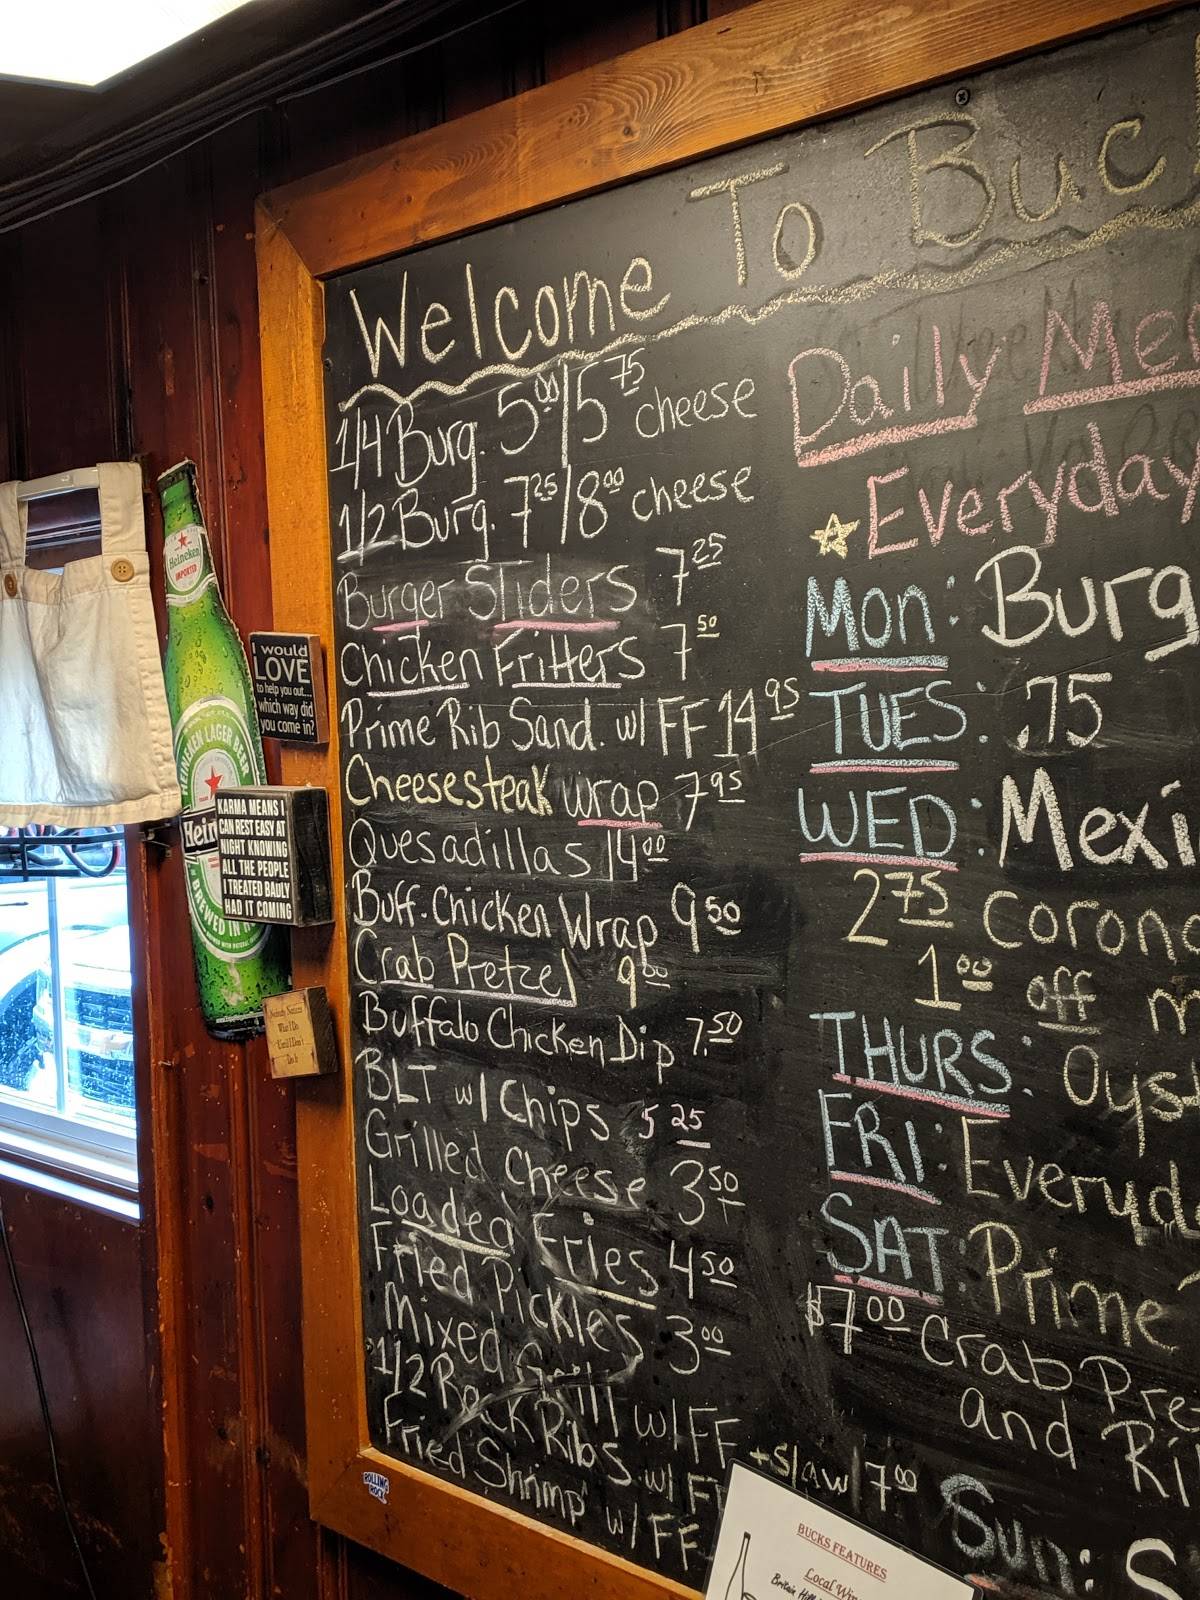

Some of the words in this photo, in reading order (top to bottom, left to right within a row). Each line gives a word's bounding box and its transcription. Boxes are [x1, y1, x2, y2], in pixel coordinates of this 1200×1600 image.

[350, 256, 672, 378] Welcome
[687, 162, 816, 287] To
[864, 33, 1200, 248] Buc
[788, 325, 1002, 458] Daily
[330, 406, 381, 490] 1/4
[387, 399, 486, 503] Burg.
[636, 377, 757, 439] cheese
[337, 490, 388, 566] 1/2
[398, 488, 496, 563] Burg.
[632, 465, 755, 522] cheese
[867, 422, 1200, 560] Everyday
[169, 548, 200, 569] Heineken
[337, 571, 455, 640] Burger
[464, 552, 638, 622] Sliders
[974, 545, 1200, 662] Burg
[252, 642, 256, 654] I
[260, 644, 308, 657] would
[254, 656, 310, 683] LOVE
[340, 633, 483, 688] Chicken
[494, 627, 646, 688] Fritters
[256, 683, 264, 693] to
[264, 683, 279, 697] help
[280, 686, 292, 697] you
[258, 697, 281, 714] which
[282, 703, 298, 719] way
[301, 701, 313, 717] did
[341, 696, 437, 748] Prime
[437, 698, 500, 751] Rib
[508, 696, 604, 752] Sand.
[1017, 672, 1113, 749] .75
[181, 730, 204, 796] HEINEKEN
[205, 724, 232, 746] LAGER
[233, 736, 250, 778] BEER
[260, 719, 276, 733] you
[277, 720, 300, 733] come
[302, 719, 315, 735] in?
[217, 799, 247, 815] KARMA
[249, 799, 278, 816] MEANS
[281, 799, 285, 816] I
[345, 752, 554, 817] Cheesesteak
[999, 767, 1200, 871] Mexi
[183, 816, 218, 848] Hein
[219, 819, 234, 834] CAN
[236, 819, 254, 835] REST
[255, 819, 275, 836] EASY
[276, 820, 285, 837] AT
[220, 839, 245, 855] NIGHT
[248, 840, 287, 857] KNOWING
[349, 817, 592, 878] Quesadillas
[222, 859, 237, 874] ALL
[239, 860, 256, 876] THE
[258, 860, 289, 878] PEOPLE
[224, 879, 227, 894] I
[228, 879, 263, 896] TREATED
[265, 881, 290, 898] BADLY
[191, 878, 226, 935] BREWED
[228, 920, 241, 937] IN
[224, 899, 242, 915] HAD
[245, 900, 254, 916] IT
[257, 901, 292, 919] COMING
[350, 868, 428, 927] Buff.
[432, 884, 552, 938] Chicken
[559, 891, 658, 965] Wrap
[354, 929, 436, 984] Crab
[450, 932, 577, 1005] Pretzel
[1027, 965, 1097, 1023] off
[358, 989, 480, 1047] Buffalo
[488, 1006, 605, 1067] Chicken
[610, 1014, 675, 1084] Dip
[355, 1047, 437, 1104] BLT
[500, 1079, 609, 1151] Chips
[365, 1108, 483, 1180] Grilled
[504, 1146, 646, 1209] Cheese
[961, 1115, 1200, 1247] Everyd
[369, 1163, 516, 1252] Loaded
[533, 1212, 659, 1297] Fries
[370, 1219, 473, 1305] Fried
[482, 1256, 645, 1361] Pickles
[967, 1220, 1178, 1351] Prime
[373, 1340, 426, 1397] 1/2
[385, 1281, 506, 1384] Mixed
[920, 1314, 1072, 1391] Crab
[1080, 1354, 1200, 1432] Pre
[383, 1391, 466, 1479] Fried
[474, 1437, 588, 1527] Shrimp
[959, 1386, 1079, 1470] and
[1101, 1419, 1200, 1507] Ri
[797, 1523, 831, 1549] BUCKS
[833, 1542, 888, 1580] FEATURES
[805, 1568, 837, 1592] Local
